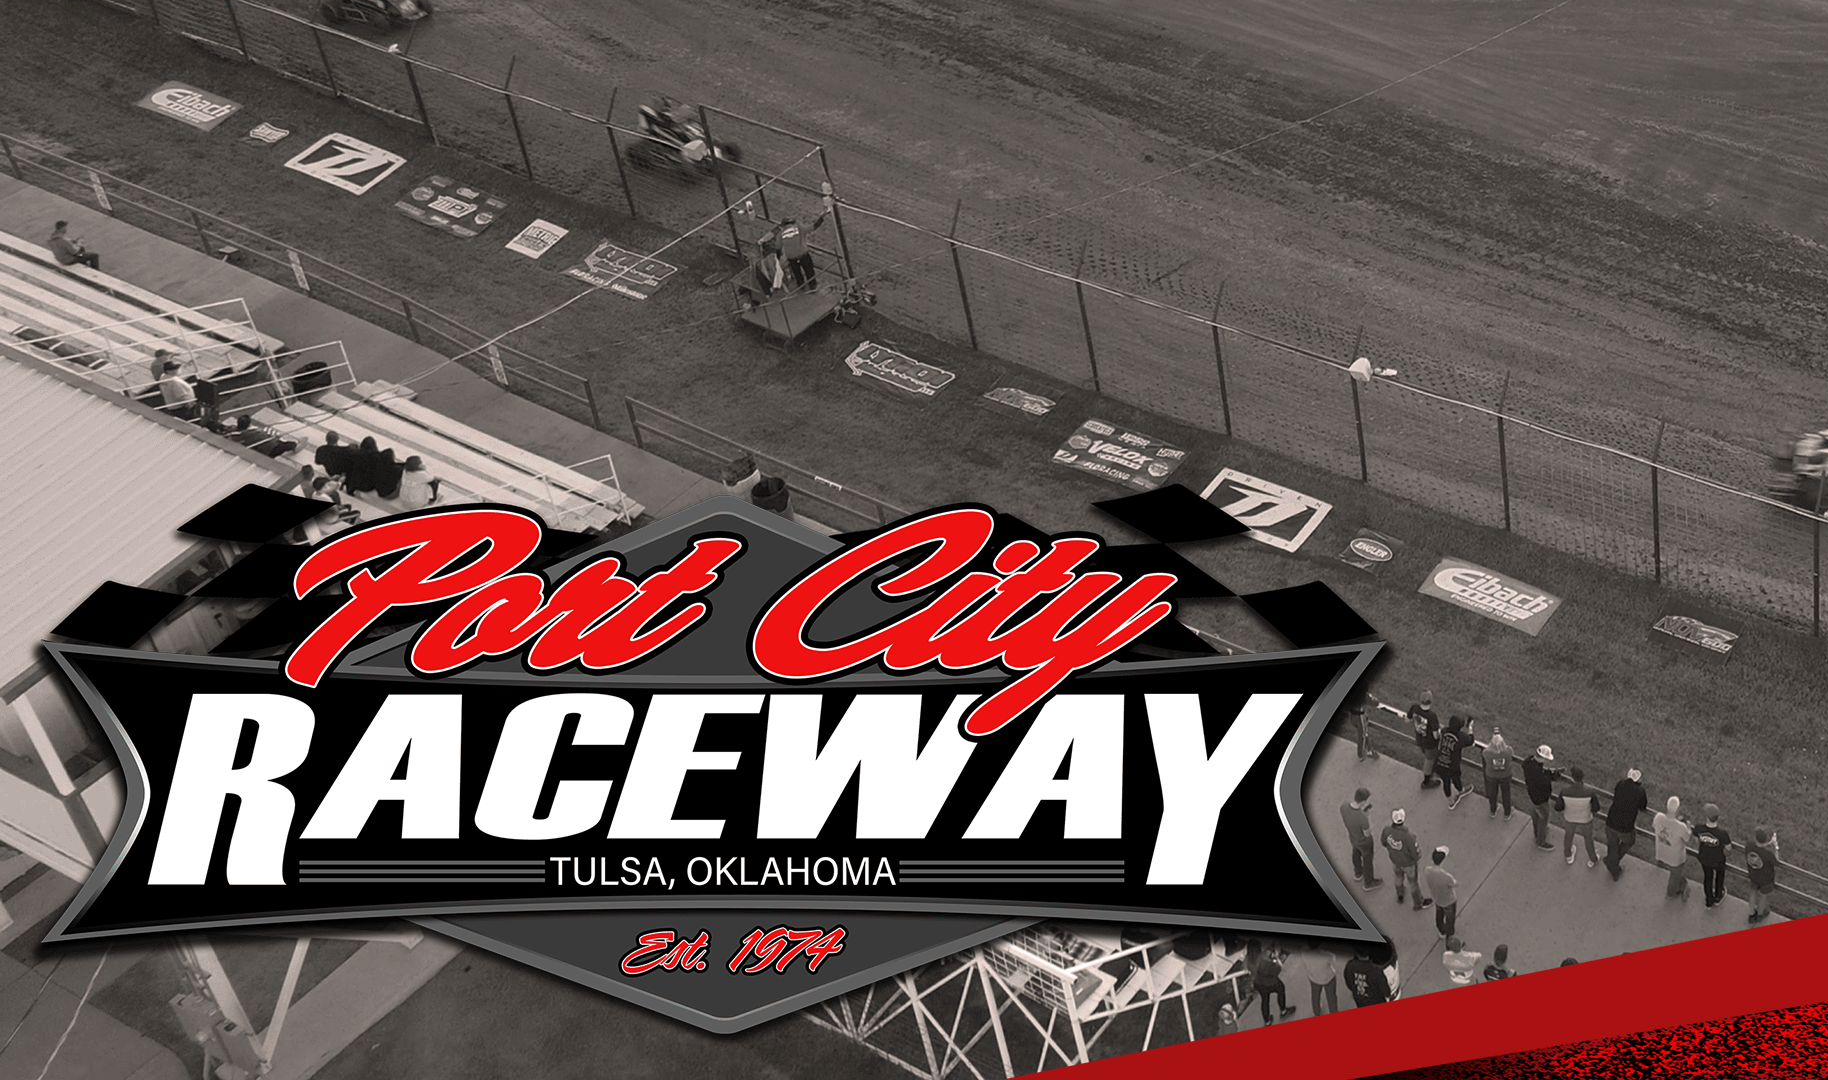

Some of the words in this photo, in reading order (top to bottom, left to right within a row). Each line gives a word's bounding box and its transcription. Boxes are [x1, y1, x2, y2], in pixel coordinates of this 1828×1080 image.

[151, 88, 237, 122] Eibach
[1086, 438, 1155, 466] VELOX
[1352, 540, 1391, 560] ENGLER
[1434, 566, 1554, 619] Eibach
